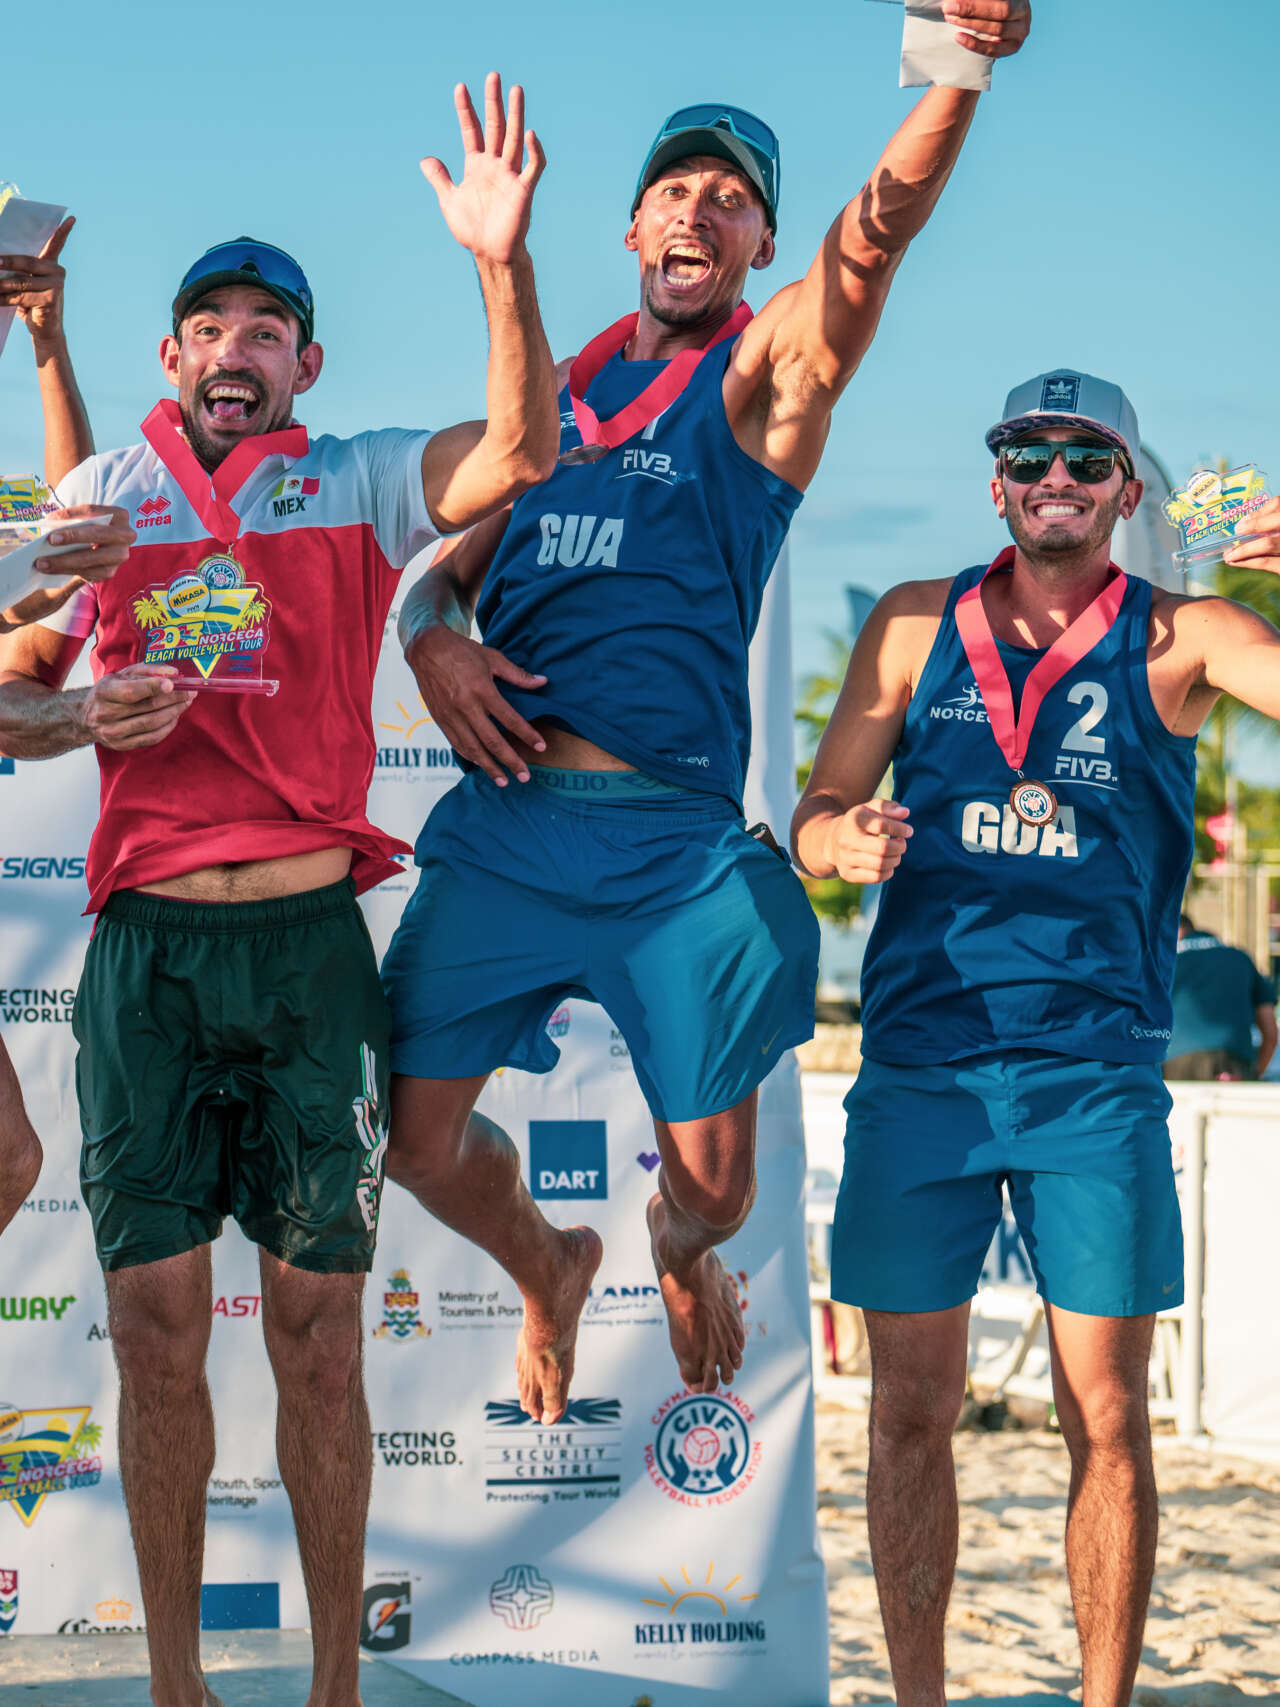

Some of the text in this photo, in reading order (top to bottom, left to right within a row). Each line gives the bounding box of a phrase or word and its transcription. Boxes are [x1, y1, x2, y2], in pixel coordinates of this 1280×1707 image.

[623, 449, 671, 473] FIVB
[273, 497, 306, 517] MEX
[537, 513, 624, 568] GUA
[199, 628, 264, 646] NORCECA
[145, 638, 264, 664] BEACH VOLLEYBALL TOUR
[1061, 681, 1108, 754] 2
[1054, 755, 1112, 780] FIVB
[962, 801, 1079, 858] GUA
[540, 1171, 599, 1190] DART
[22, 1199, 80, 1212] MEDIA
[439, 1290, 499, 1305] Ministry of
[439, 1306, 484, 1319] Tourism
[487, 1306, 495, 1319] &
[652, 1388, 691, 1425] CAYMA
[674, 1406, 735, 1434] CIVF
[537, 1433, 573, 1445] THE
[383, 1450, 464, 1466] WORLD.
[502, 1448, 605, 1462] SECURITY
[19, 1456, 102, 1485] NORCECA
[515, 1463, 593, 1477] CENTRE
[644, 1441, 762, 1507] VOLLEYBALL FEDERATION
[486, 1487, 620, 1504] Protecting Your World
[635, 1620, 766, 1644] KELLY HOLDING
[449, 1650, 600, 1666] COMPASS MEDIA
